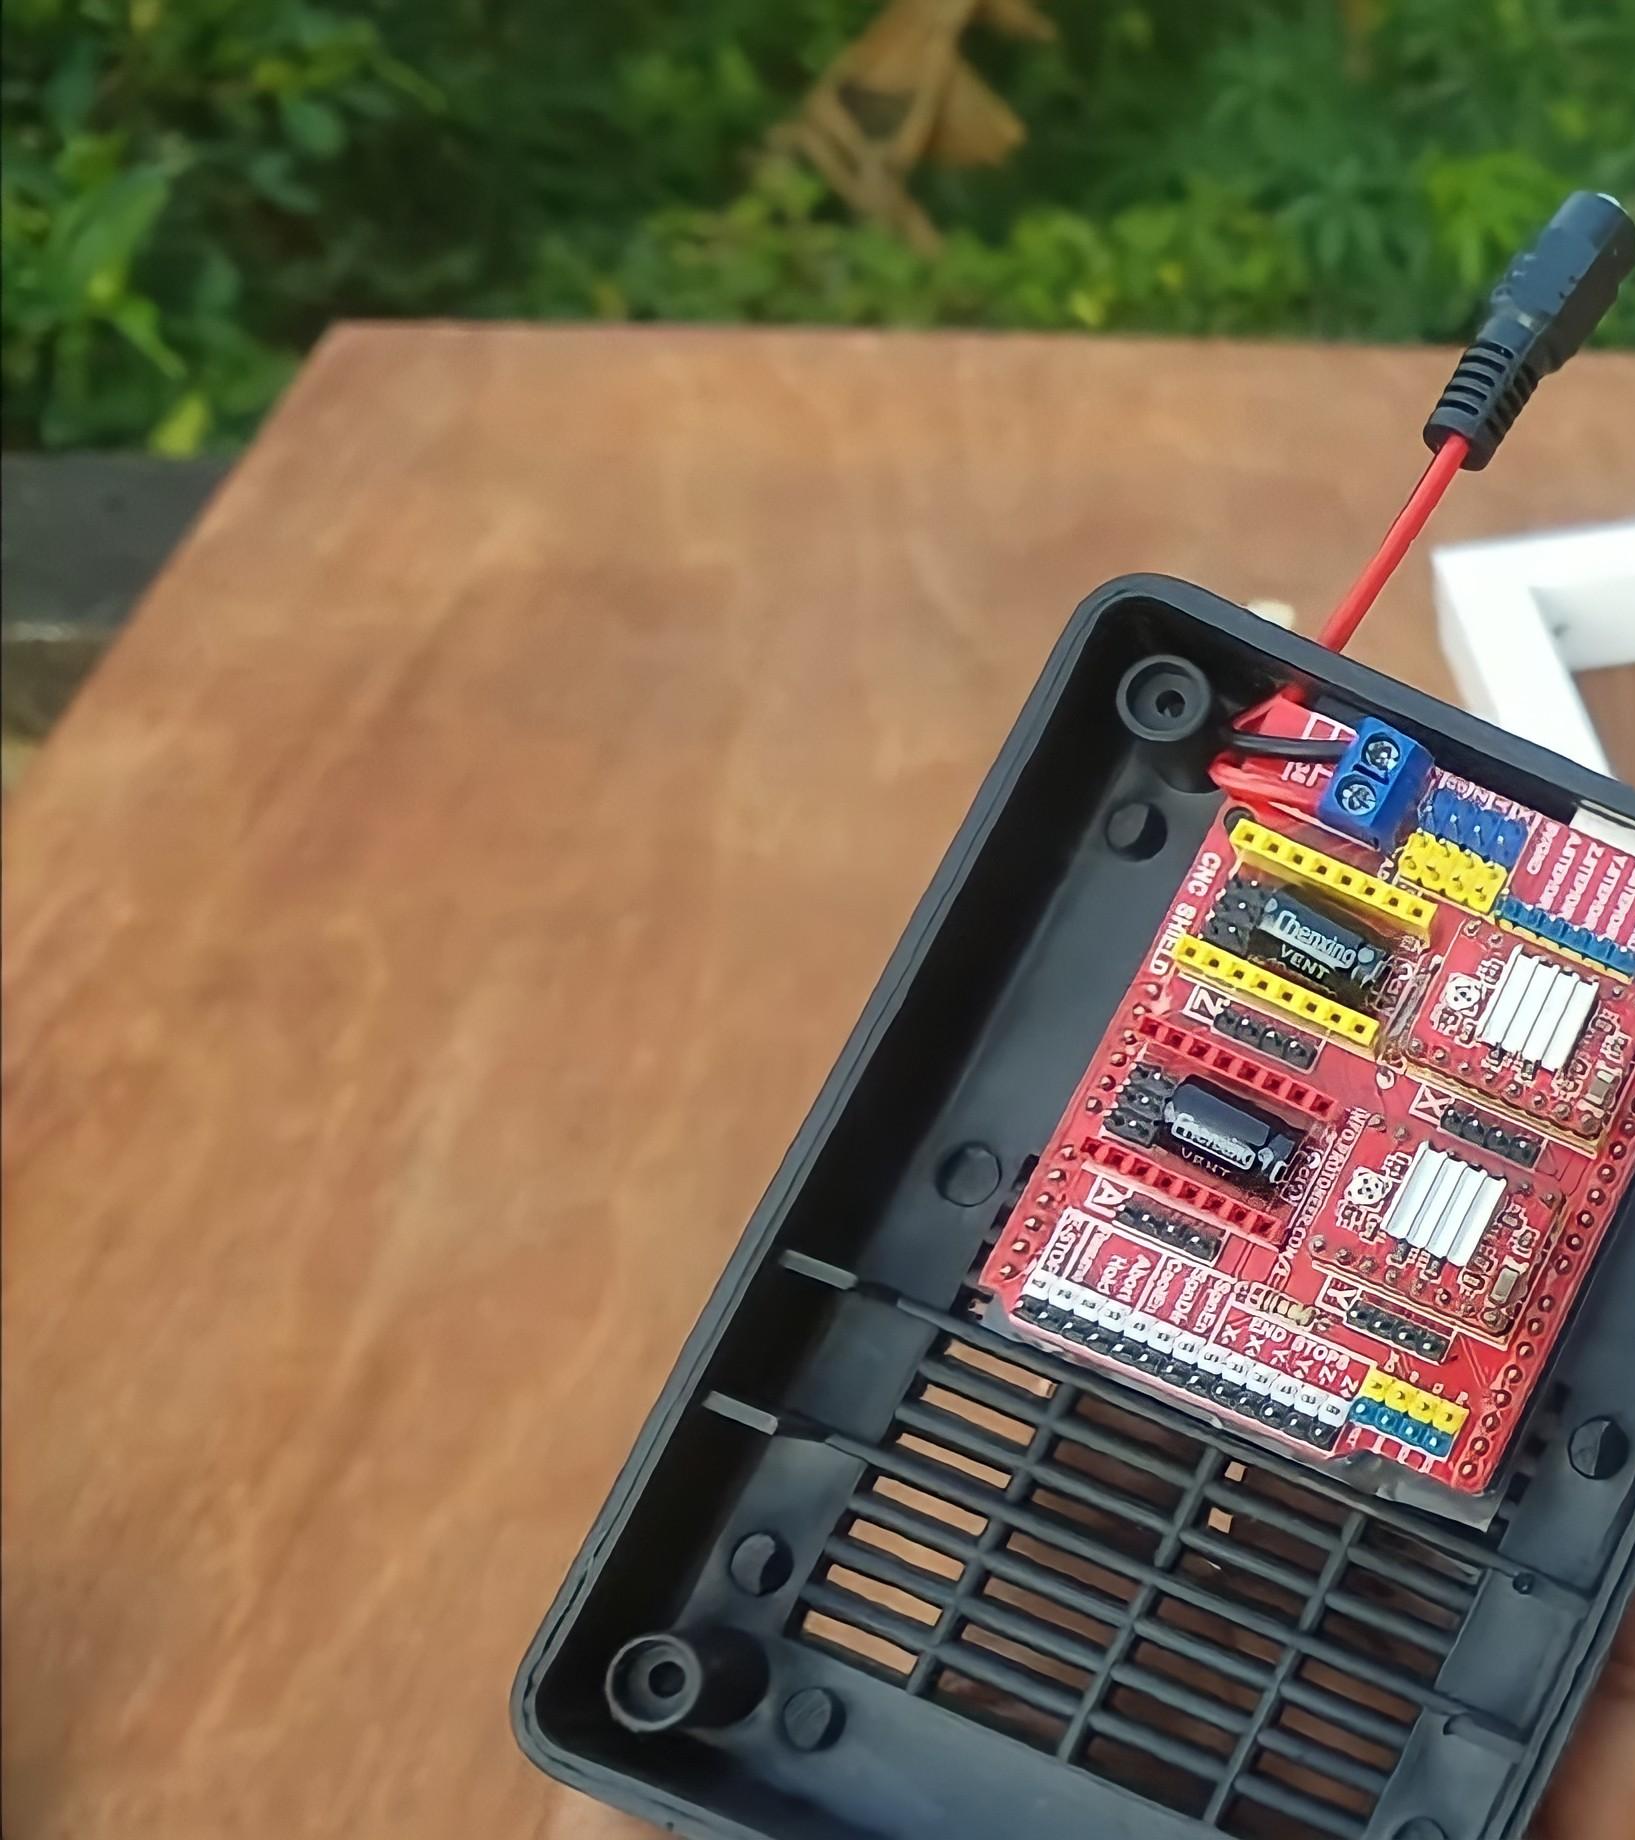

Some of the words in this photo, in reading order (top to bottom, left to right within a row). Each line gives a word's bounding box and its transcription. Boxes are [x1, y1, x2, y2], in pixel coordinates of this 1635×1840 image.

[1187, 852, 1222, 897] CNC
[1150, 902, 1198, 976] SHIELD
[1280, 943, 1331, 980] VENT
[1417, 1092, 1452, 1117] X
[1094, 1179, 1130, 1206] A
[1097, 1255, 1127, 1295] Hold
[1326, 1287, 1357, 1311] Y
[1250, 1316, 1288, 1343] END
